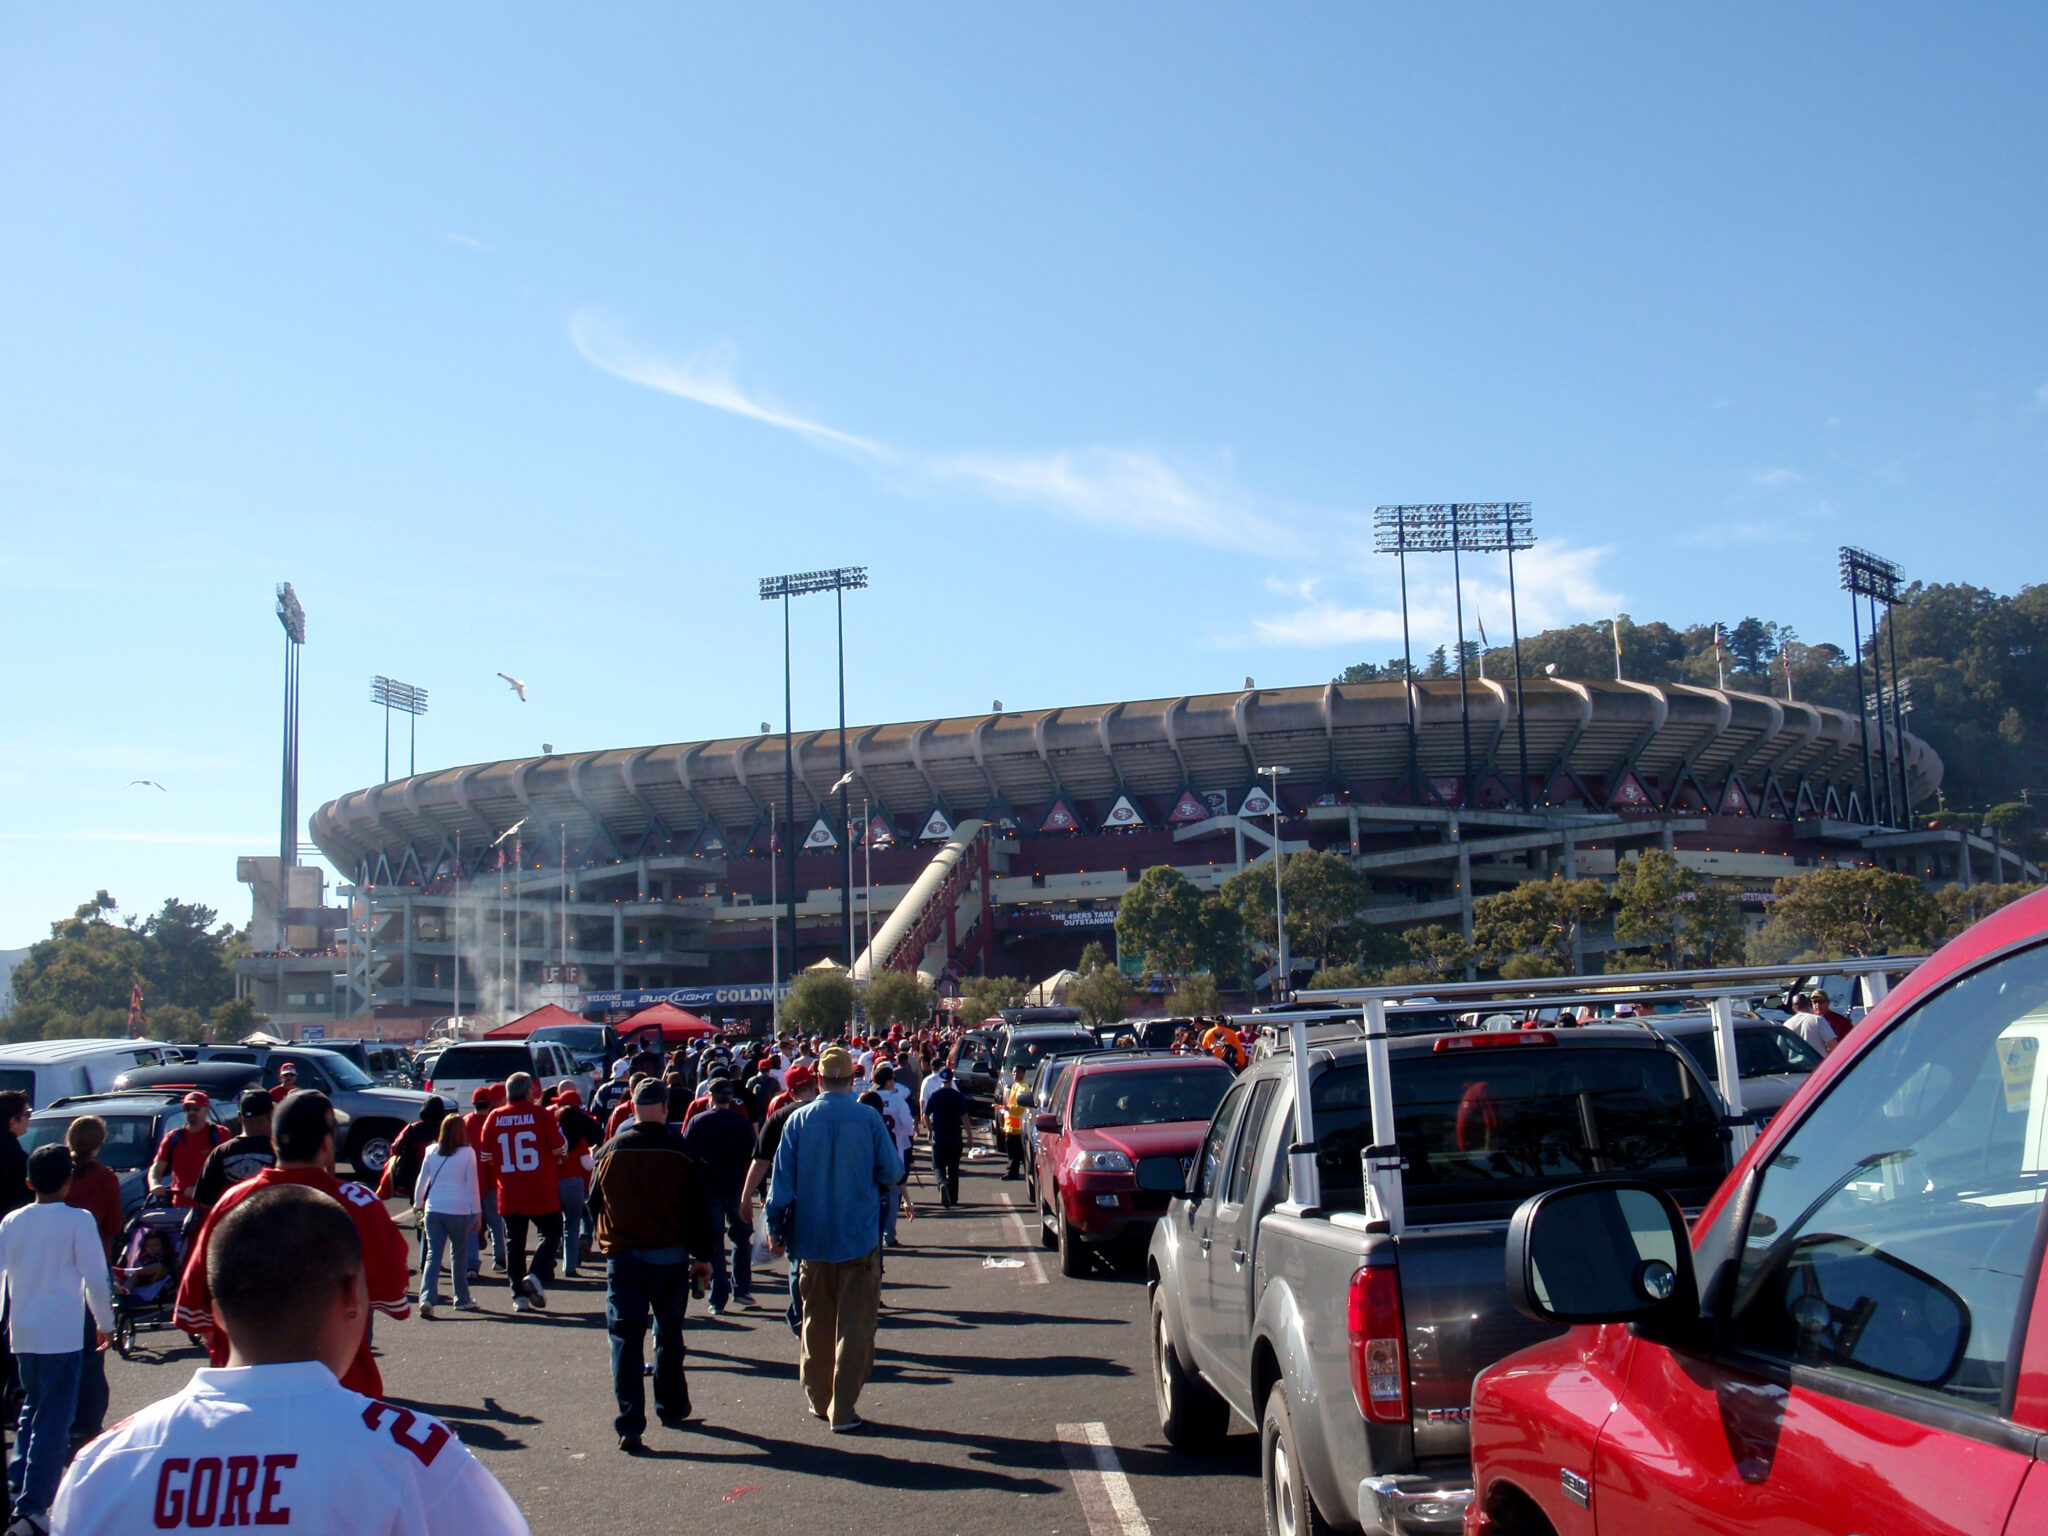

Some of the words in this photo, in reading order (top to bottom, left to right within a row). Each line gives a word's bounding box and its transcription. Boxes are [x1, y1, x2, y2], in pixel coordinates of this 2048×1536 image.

[1051, 913, 1066, 921] THE
[1067, 912, 1092, 920] 49ERS
[1094, 911, 1114, 919] TAKE
[1063, 917, 1116, 927] OUTSTANDIN
[586, 993, 622, 1003] WELCOME
[639, 994, 668, 1004] BUD
[674, 992, 714, 1002] LIGHT
[716, 986, 790, 1004] GOLDMI
[610, 1000, 620, 1008] TO
[621, 1000, 636, 1008] THE
[495, 1114, 535, 1127] MONTANA
[497, 1131, 539, 1173] 16
[153, 1453, 299, 1529] GORE
